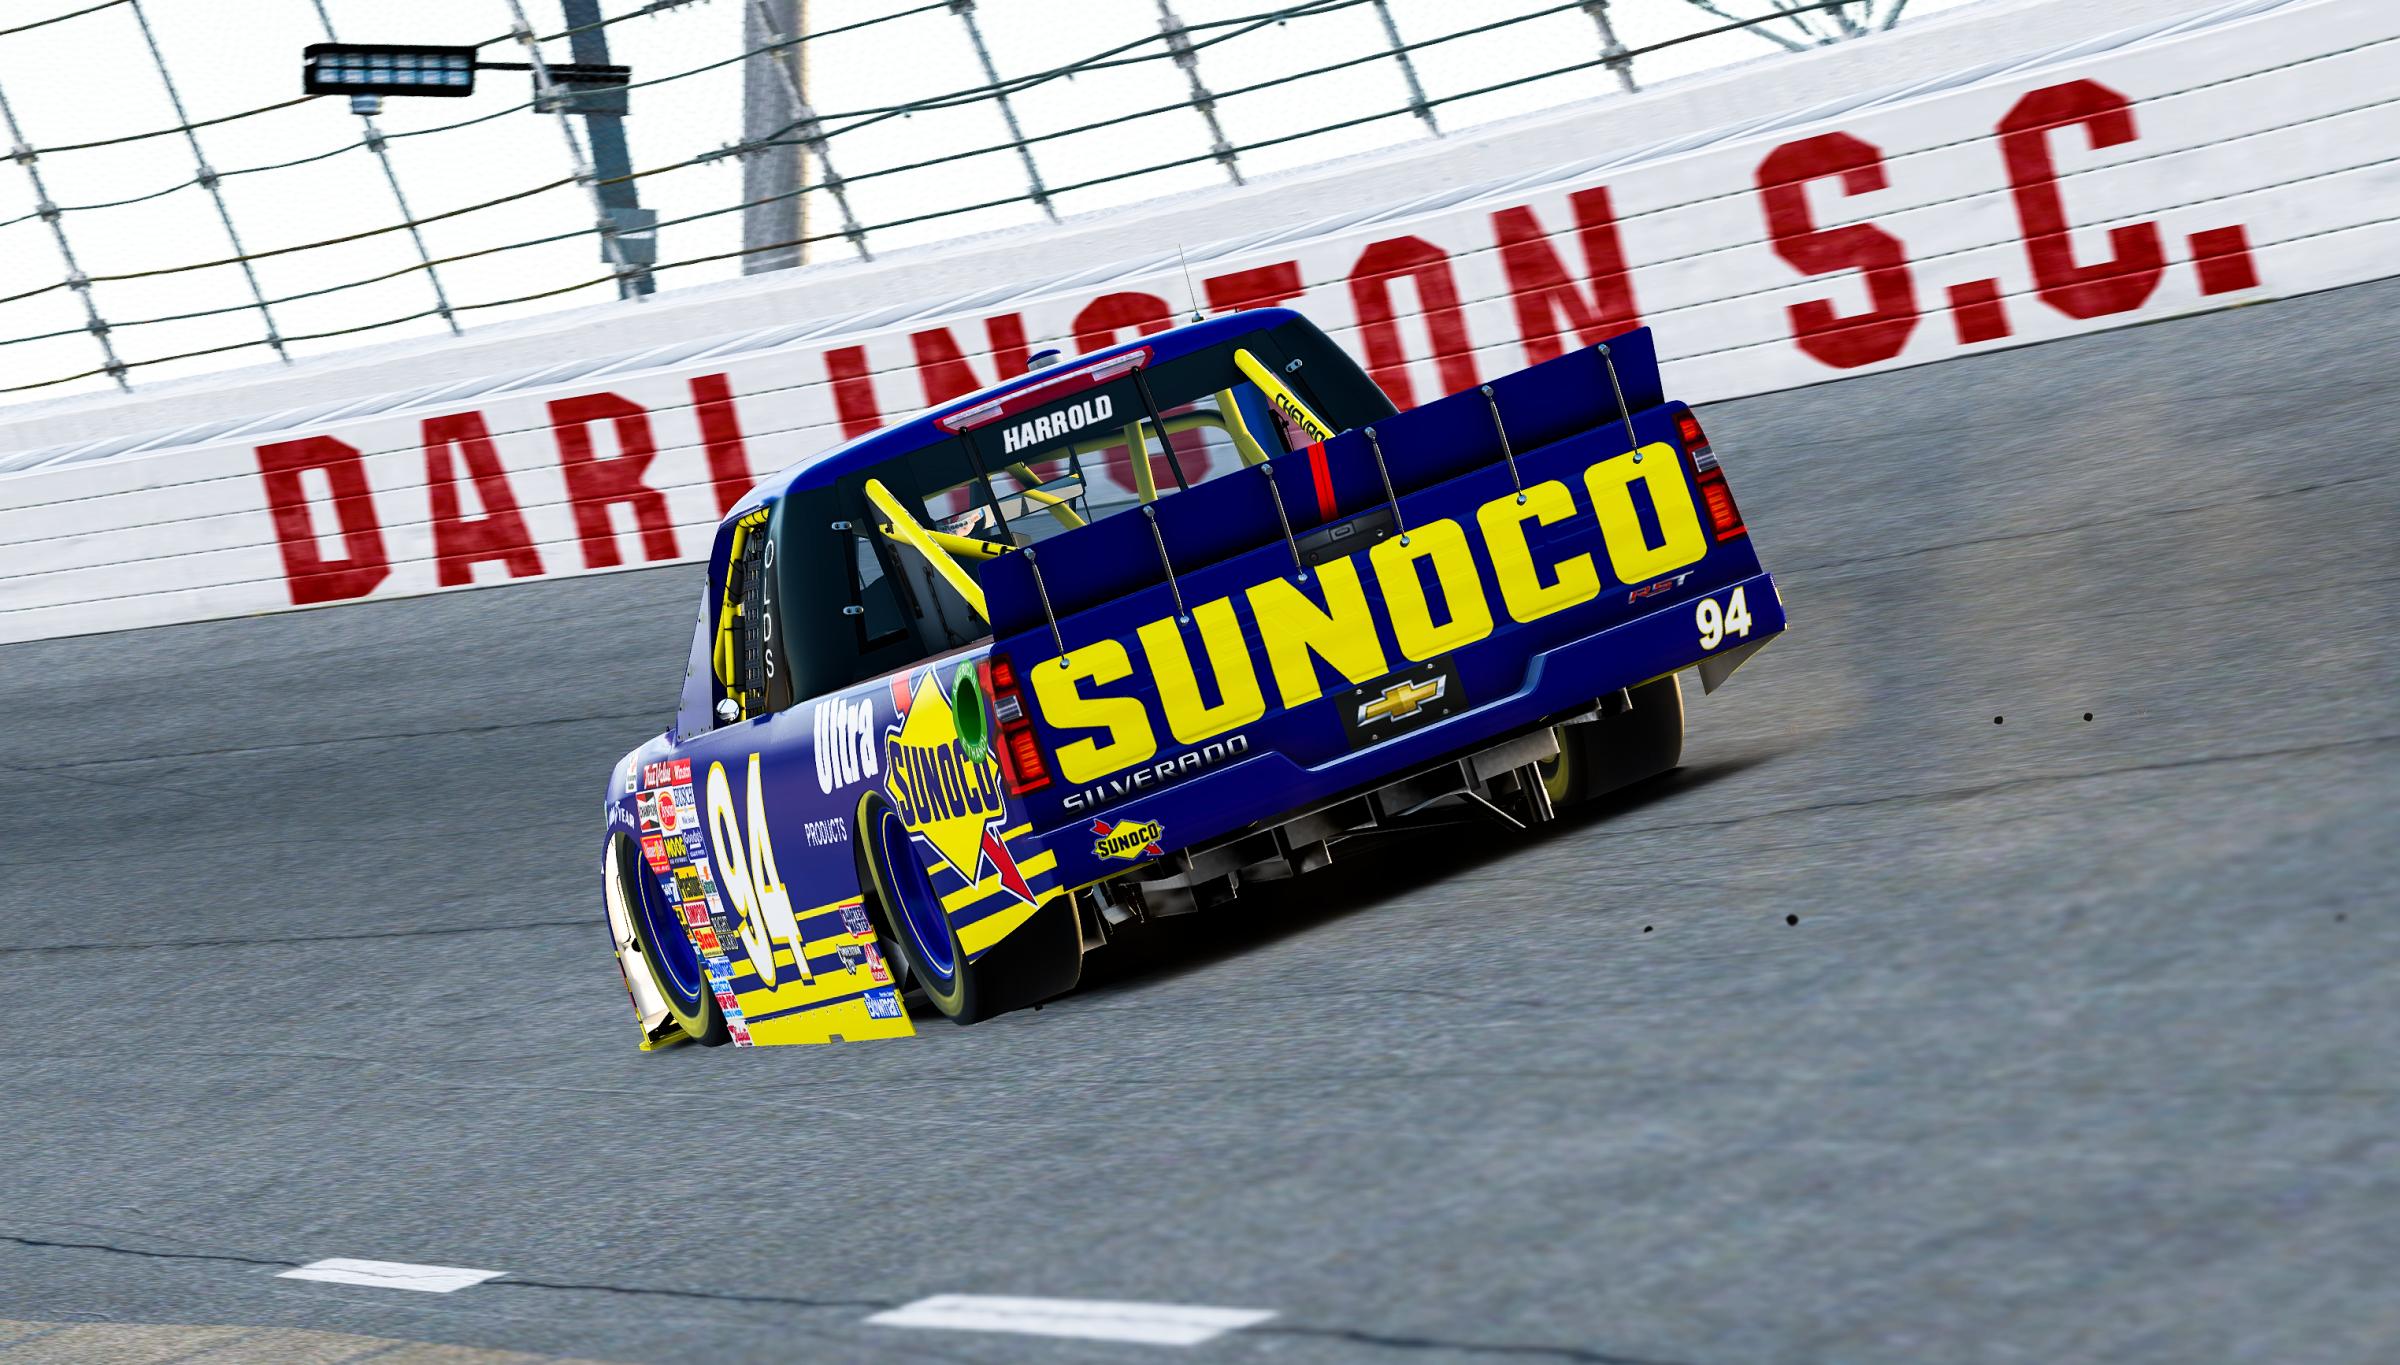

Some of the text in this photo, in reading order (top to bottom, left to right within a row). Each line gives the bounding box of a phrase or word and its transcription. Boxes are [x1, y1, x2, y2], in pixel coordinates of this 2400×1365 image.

[1003, 394, 1112, 454] HARROLD
[1275, 393, 1328, 442] CHEVRO
[1031, 442, 1707, 785] SUNOCO
[1628, 570, 1695, 605] RST
[1696, 586, 1752, 650] 94
[813, 696, 879, 795] Ultra
[1063, 734, 1249, 814] SILVERADO
[888, 737, 1001, 827] SUNOCO
[664, 835, 687, 858] MOOG
[804, 817, 848, 848] PRODUCTS
[1097, 822, 1160, 858] SUNOCO
[707, 752, 815, 989] 94
[863, 992, 902, 1019] Bowman
